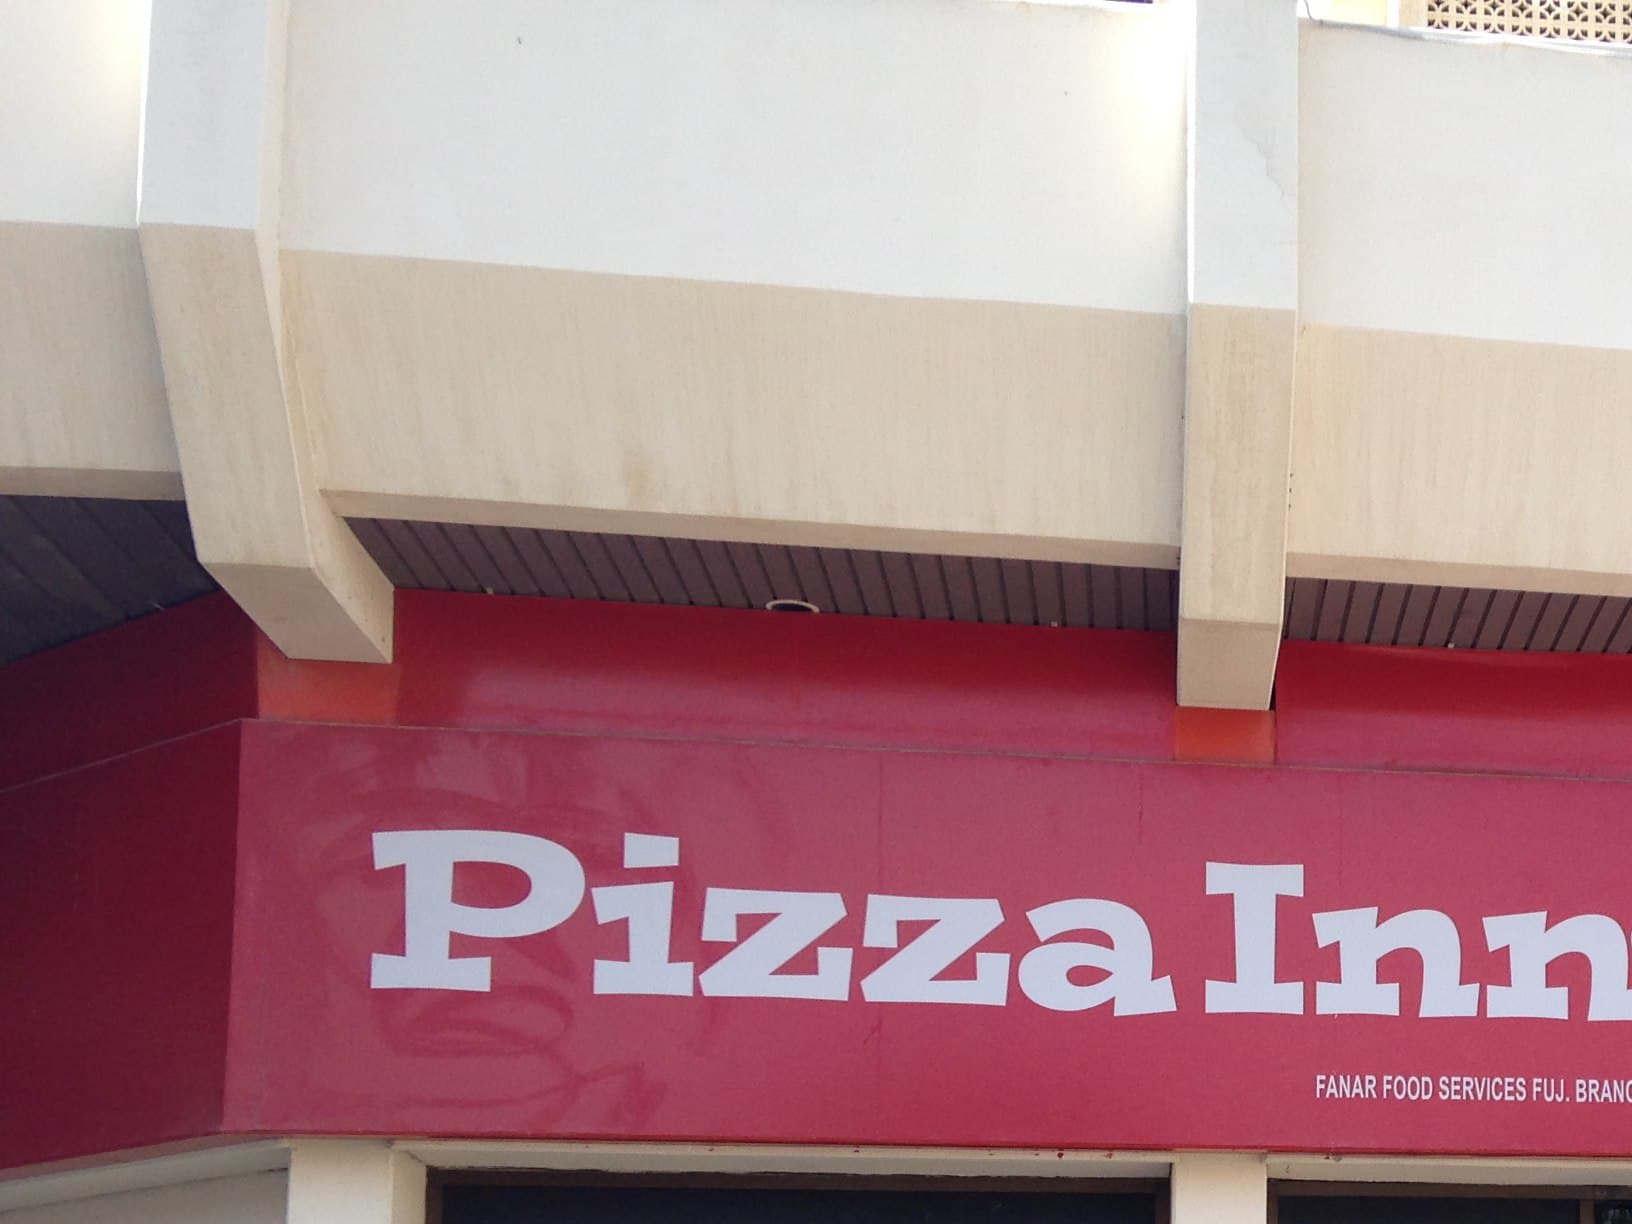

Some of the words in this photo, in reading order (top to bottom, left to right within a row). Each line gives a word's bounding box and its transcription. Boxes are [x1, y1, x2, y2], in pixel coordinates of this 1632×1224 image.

[370, 829, 1177, 1017] Pizza
[1315, 1074, 1377, 1099] FANAR
[1383, 1075, 1433, 1100] FOOD
[1438, 1076, 1527, 1102] SERVICES
[1532, 1078, 1570, 1103] FUJ.
